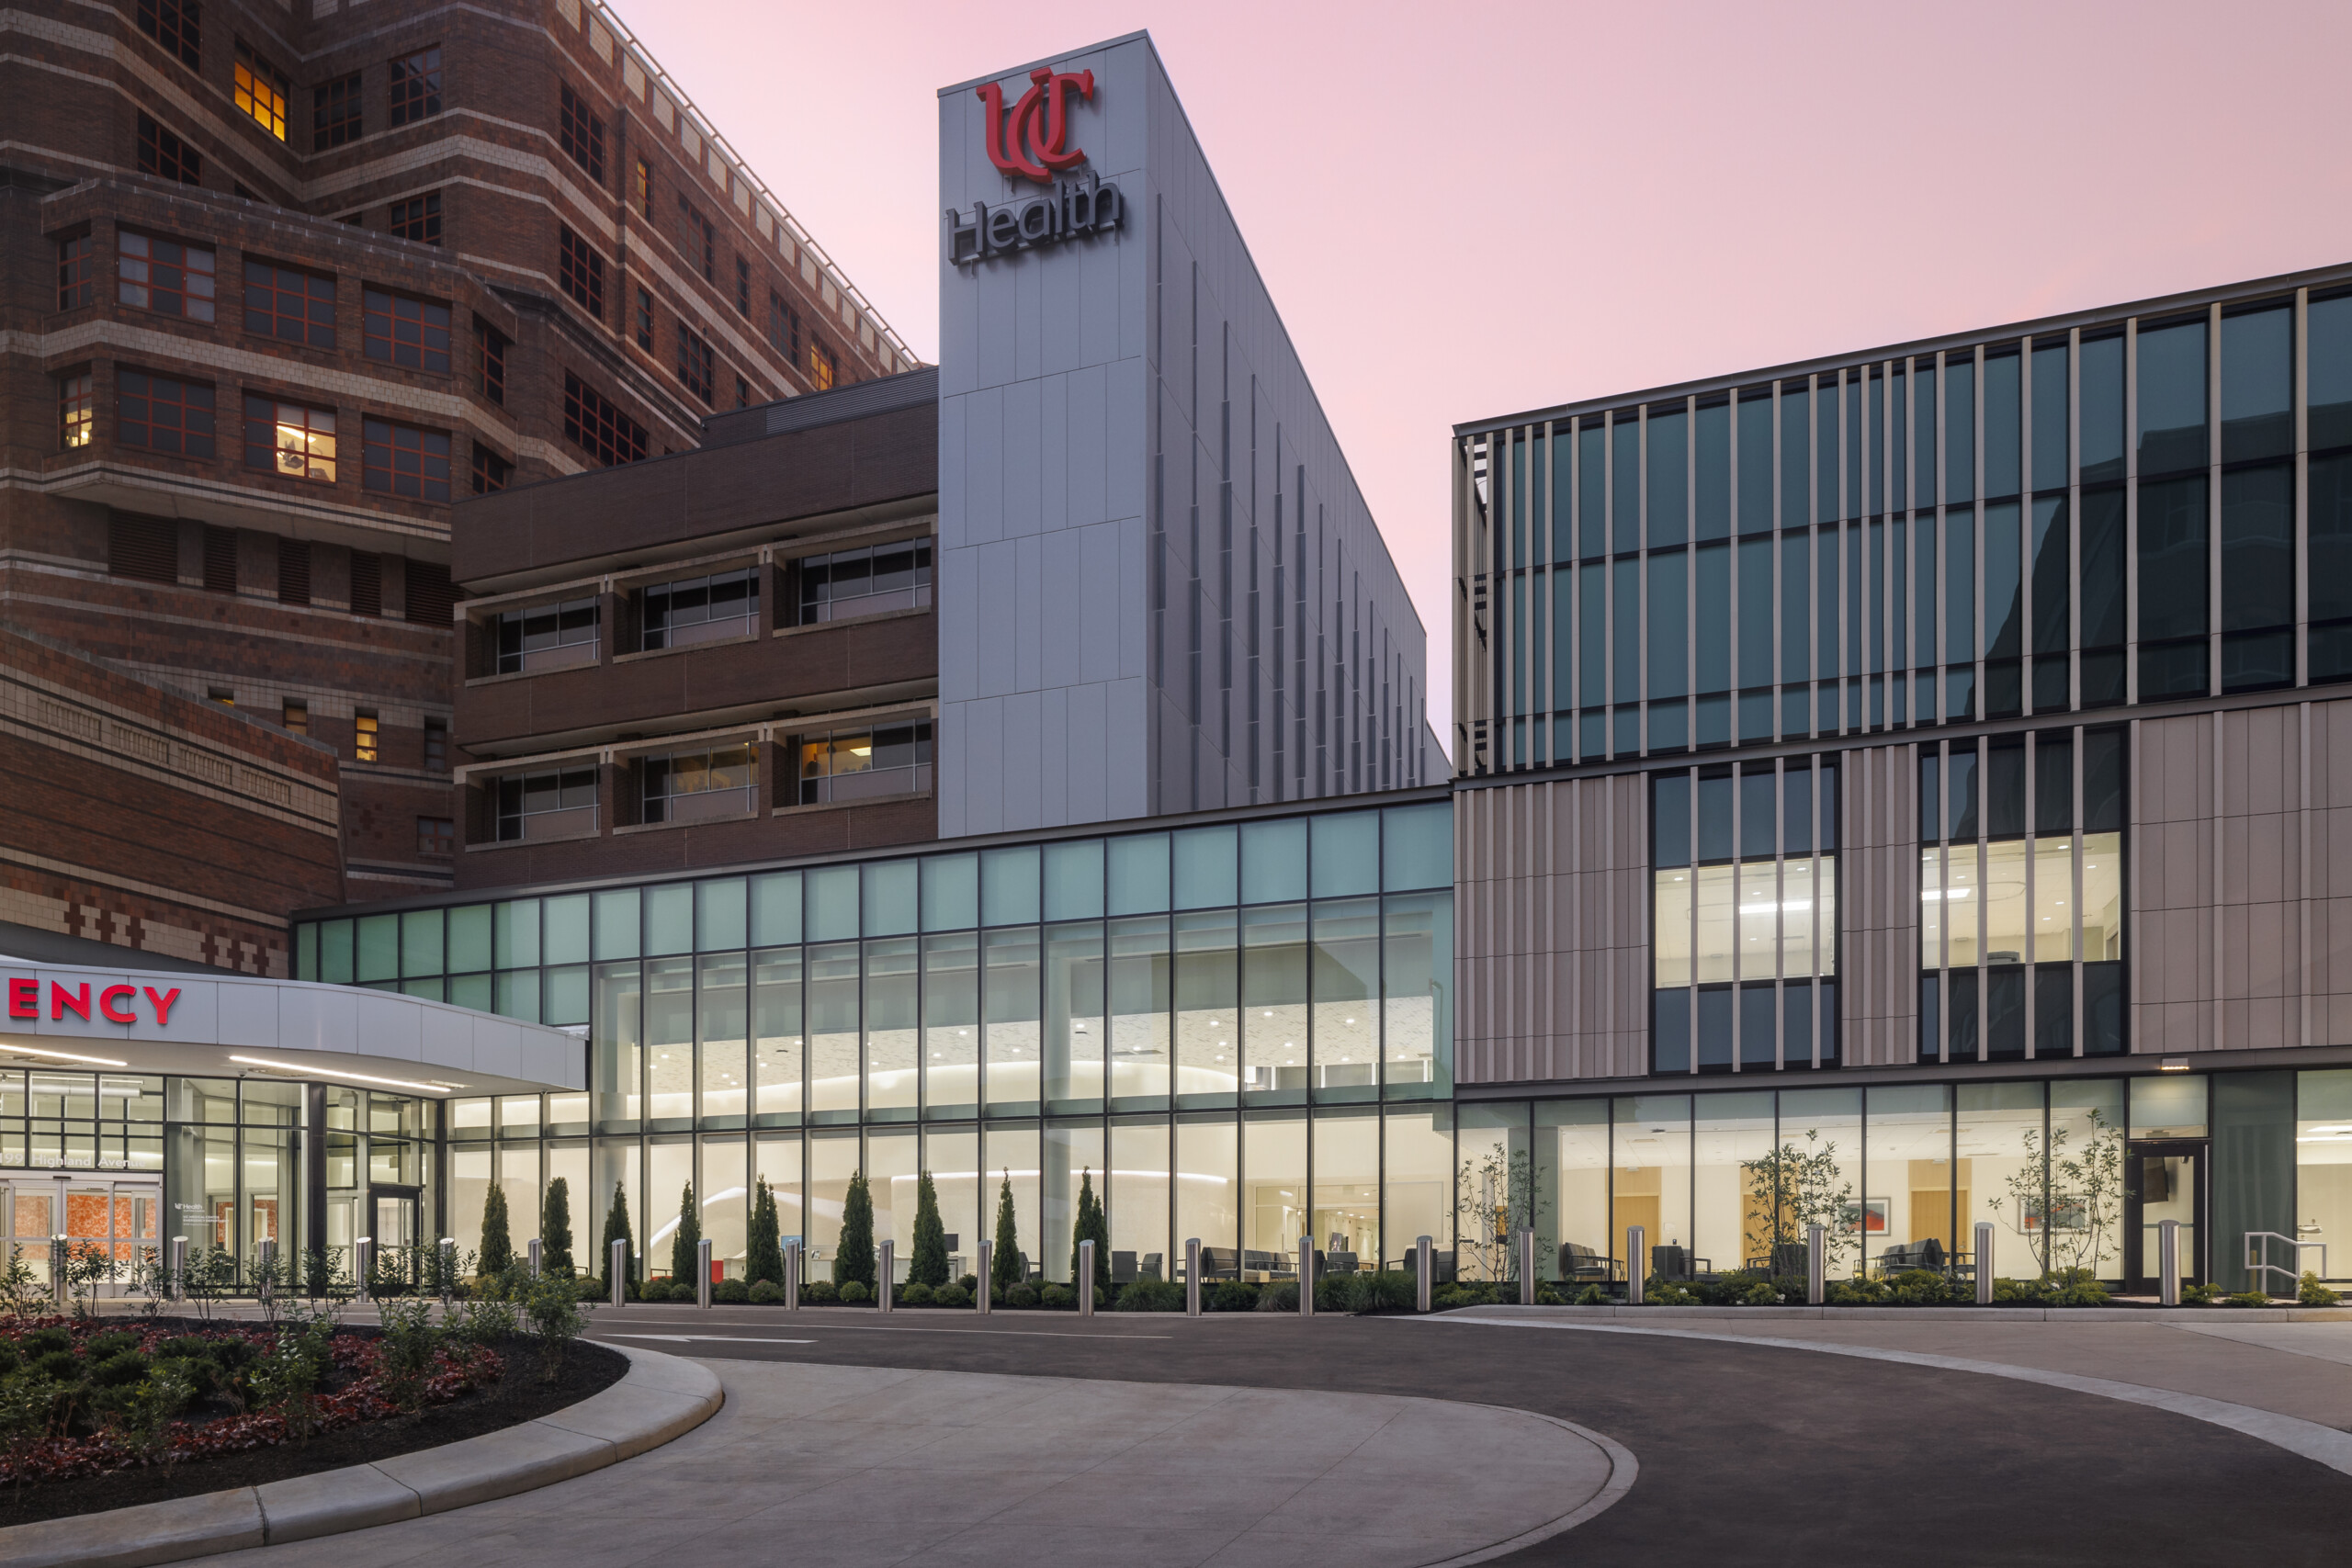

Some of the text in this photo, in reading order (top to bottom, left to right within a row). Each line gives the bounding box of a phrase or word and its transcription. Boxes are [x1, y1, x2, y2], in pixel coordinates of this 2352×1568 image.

[976, 66, 1094, 184] UC
[945, 169, 1124, 265] Health
[8, 977, 182, 1025] ENCY
[31, 1153, 91, 1168] Highland
[97, 1156, 146, 1168] Avenue
